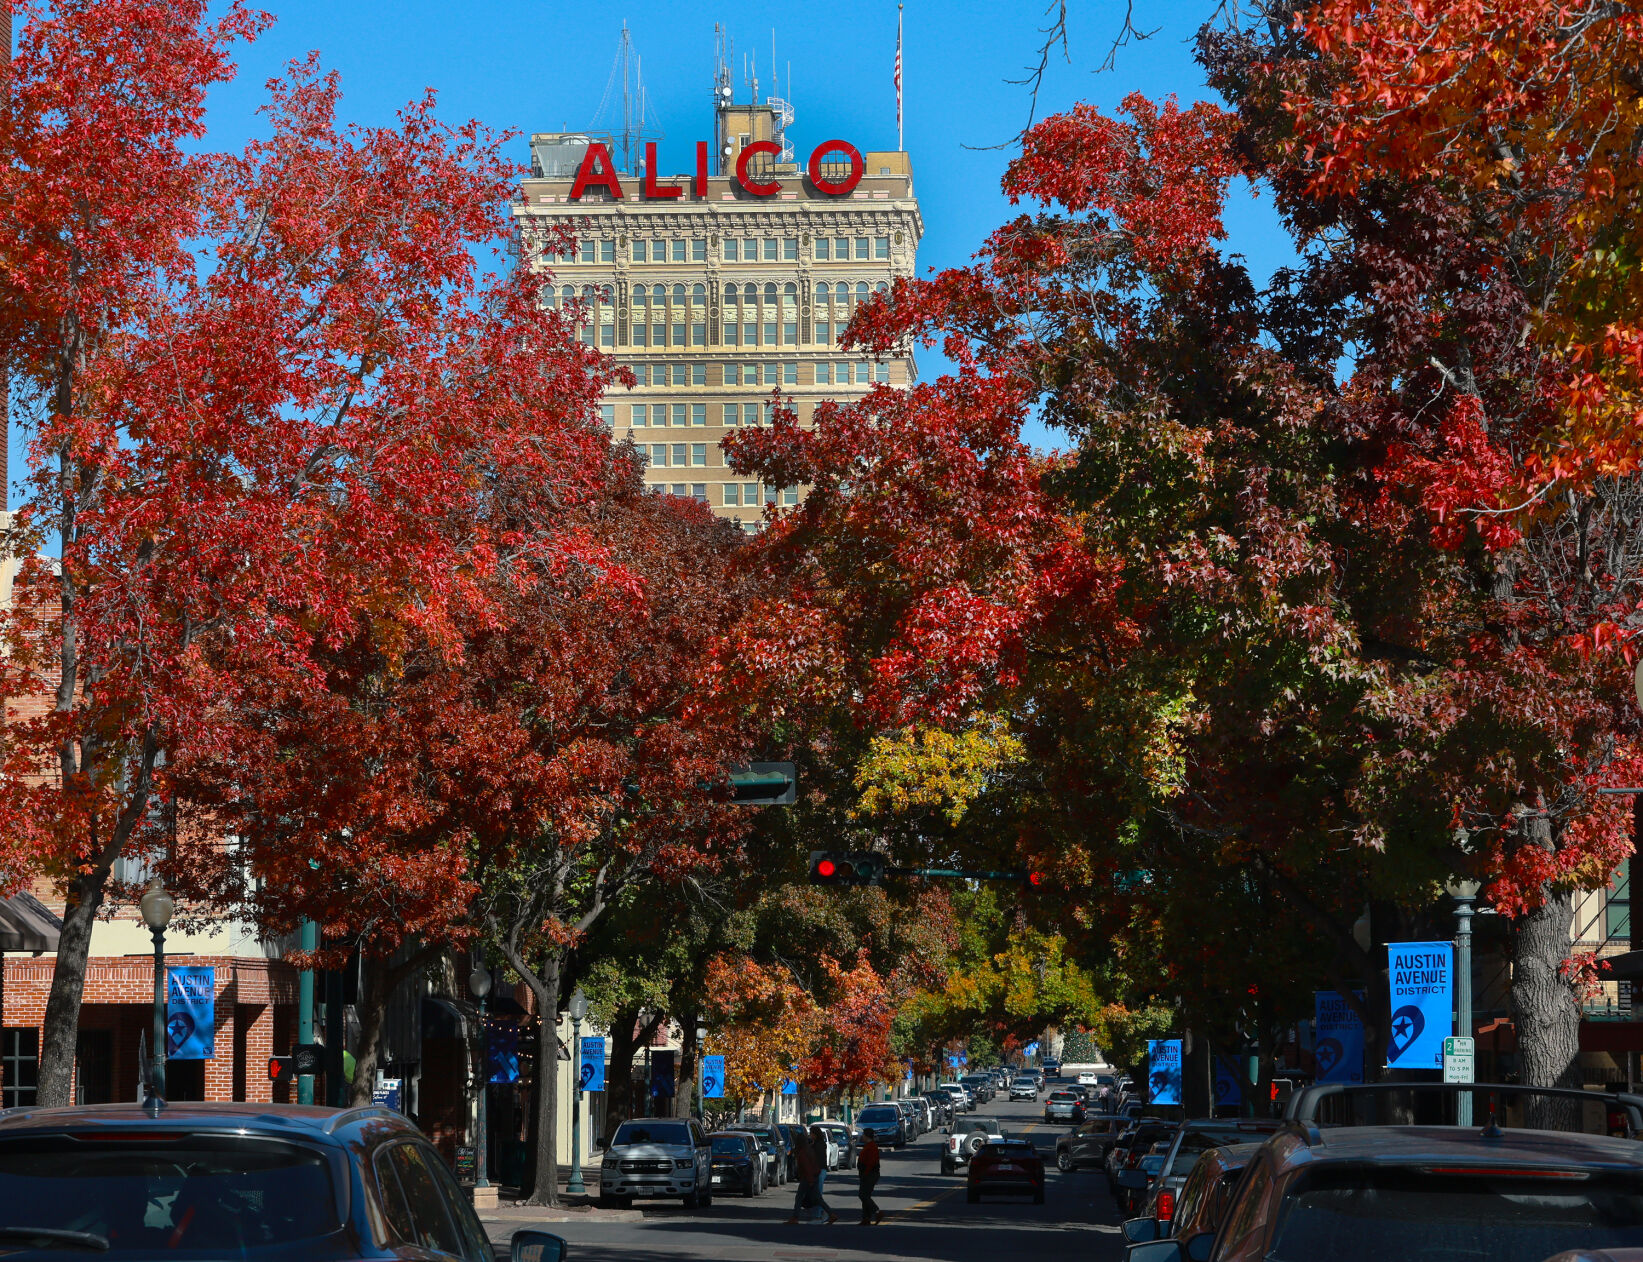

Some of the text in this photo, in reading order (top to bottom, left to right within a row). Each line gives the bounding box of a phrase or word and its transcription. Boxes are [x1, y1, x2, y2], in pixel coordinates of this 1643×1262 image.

[570, 139, 864, 198] ALICO
[1394, 953, 1446, 969] AUSTIN
[171, 975, 210, 986] AUSTIN
[1395, 970, 1447, 985] AVENUE
[171, 986, 210, 997] AVENUE
[1396, 986, 1446, 996] DISTRICT
[1447, 1042, 1453, 1051] 2
